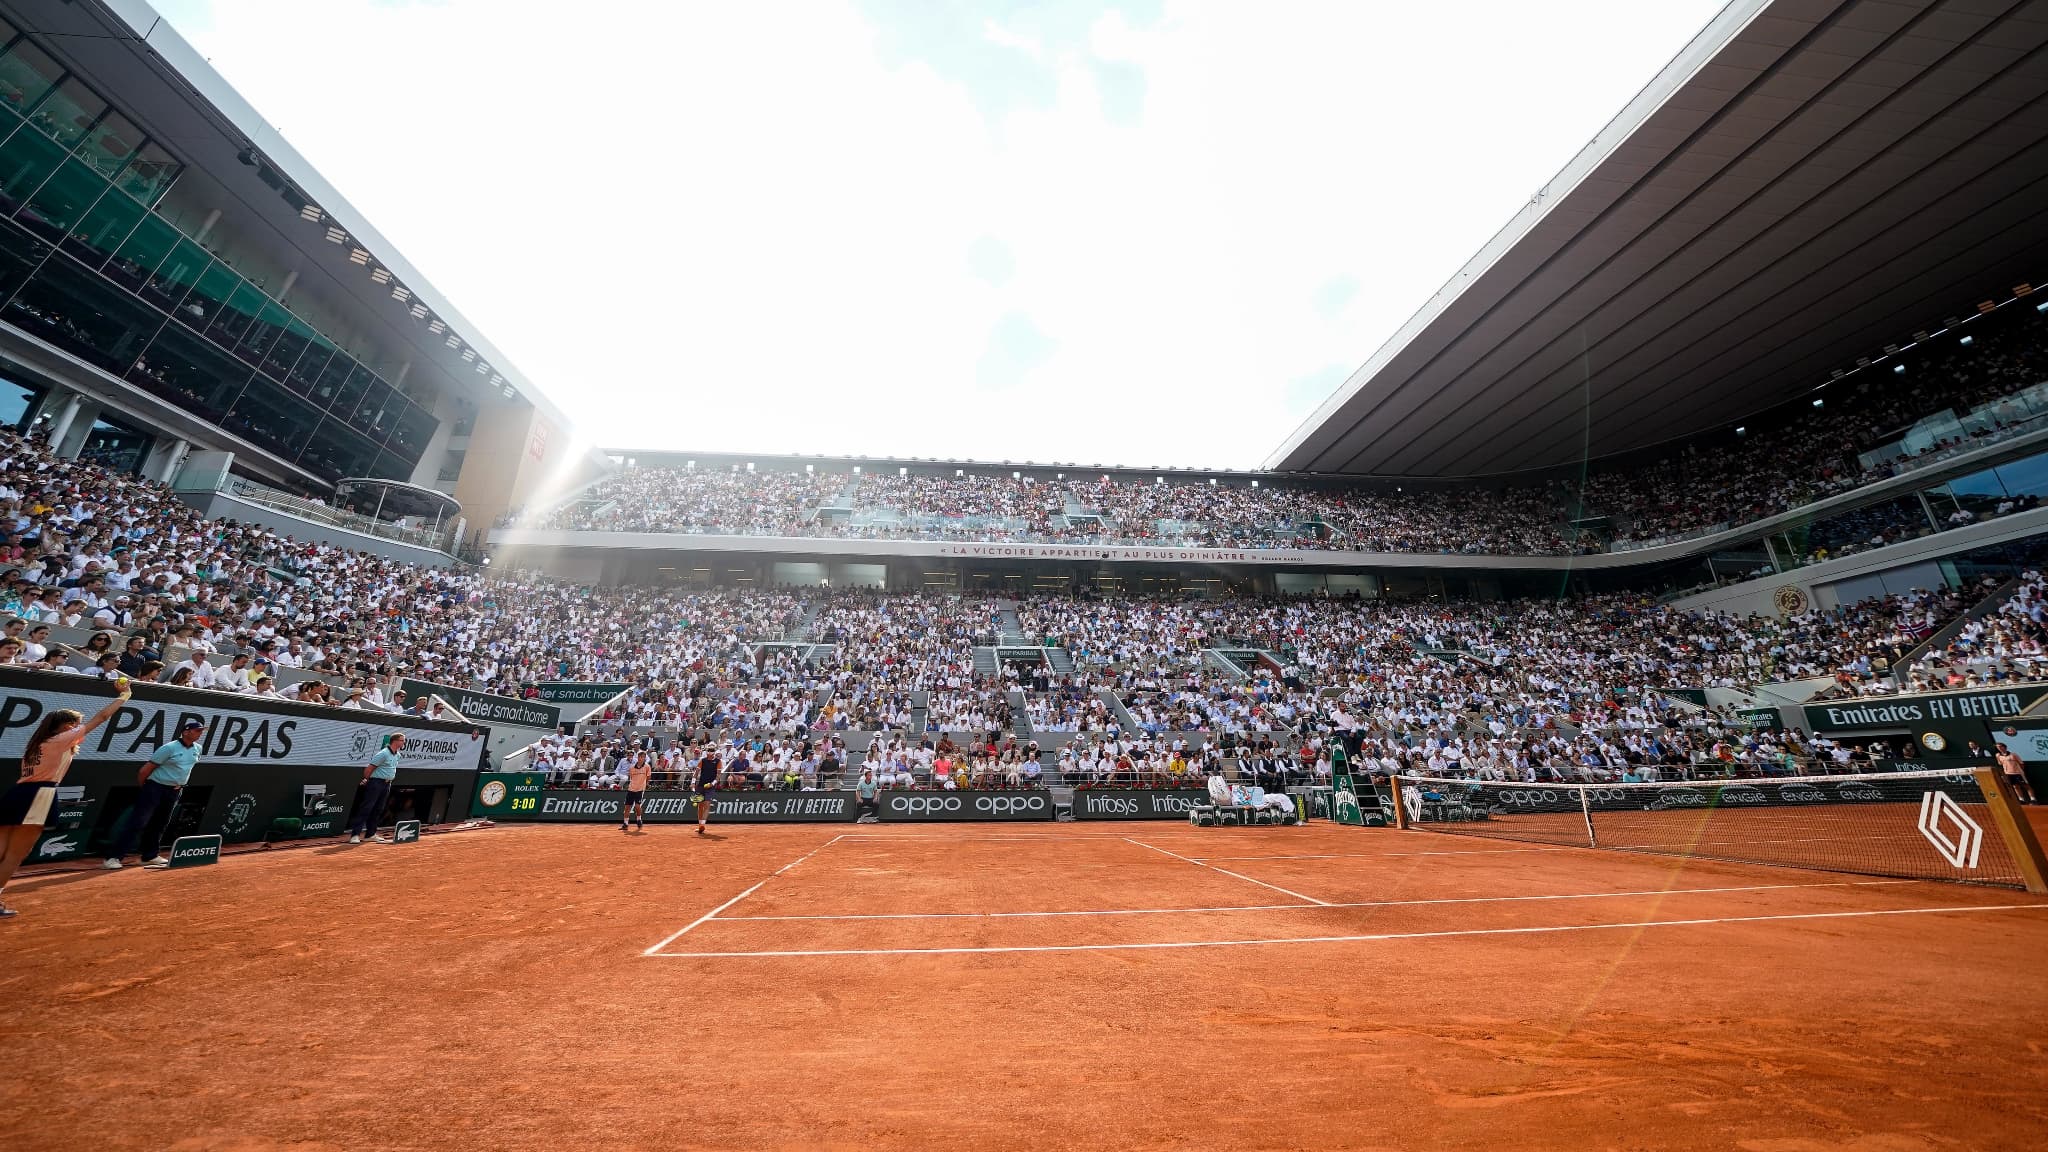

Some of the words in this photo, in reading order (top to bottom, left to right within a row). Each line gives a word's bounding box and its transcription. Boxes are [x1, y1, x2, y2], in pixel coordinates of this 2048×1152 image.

[974, 548, 1033, 556] VICTOIRE
[1180, 551, 1245, 560] OPINIÂTRE
[538, 688, 556, 699] ier
[558, 689, 591, 699] smart
[593, 689, 618, 699] hom
[460, 696, 494, 719] Haier
[494, 705, 523, 721] smart
[523, 707, 549, 724] home
[1741, 712, 1773, 722] Emirates
[1826, 704, 1923, 725] Emirates
[1929, 698, 1953, 719] FLY
[1958, 693, 2021, 717] BETTER
[400, 739, 421, 752] BNP
[421, 740, 458, 753] PARIBAS
[512, 797, 535, 810] 3:00
[543, 797, 618, 814] Emirates
[645, 799, 687, 814] BETTER
[891, 797, 961, 815] oppo
[975, 796, 1044, 815] oppo
[1086, 794, 1138, 815] Infosys
[1152, 795, 1201, 812] Infosys
[1499, 790, 1557, 806] oppo
[708, 798, 778, 815] Emirates
[784, 799, 804, 814] FLY
[805, 799, 845, 814] BETTER
[303, 822, 330, 831] LACOSTE
[174, 847, 217, 858] LACOSTE
